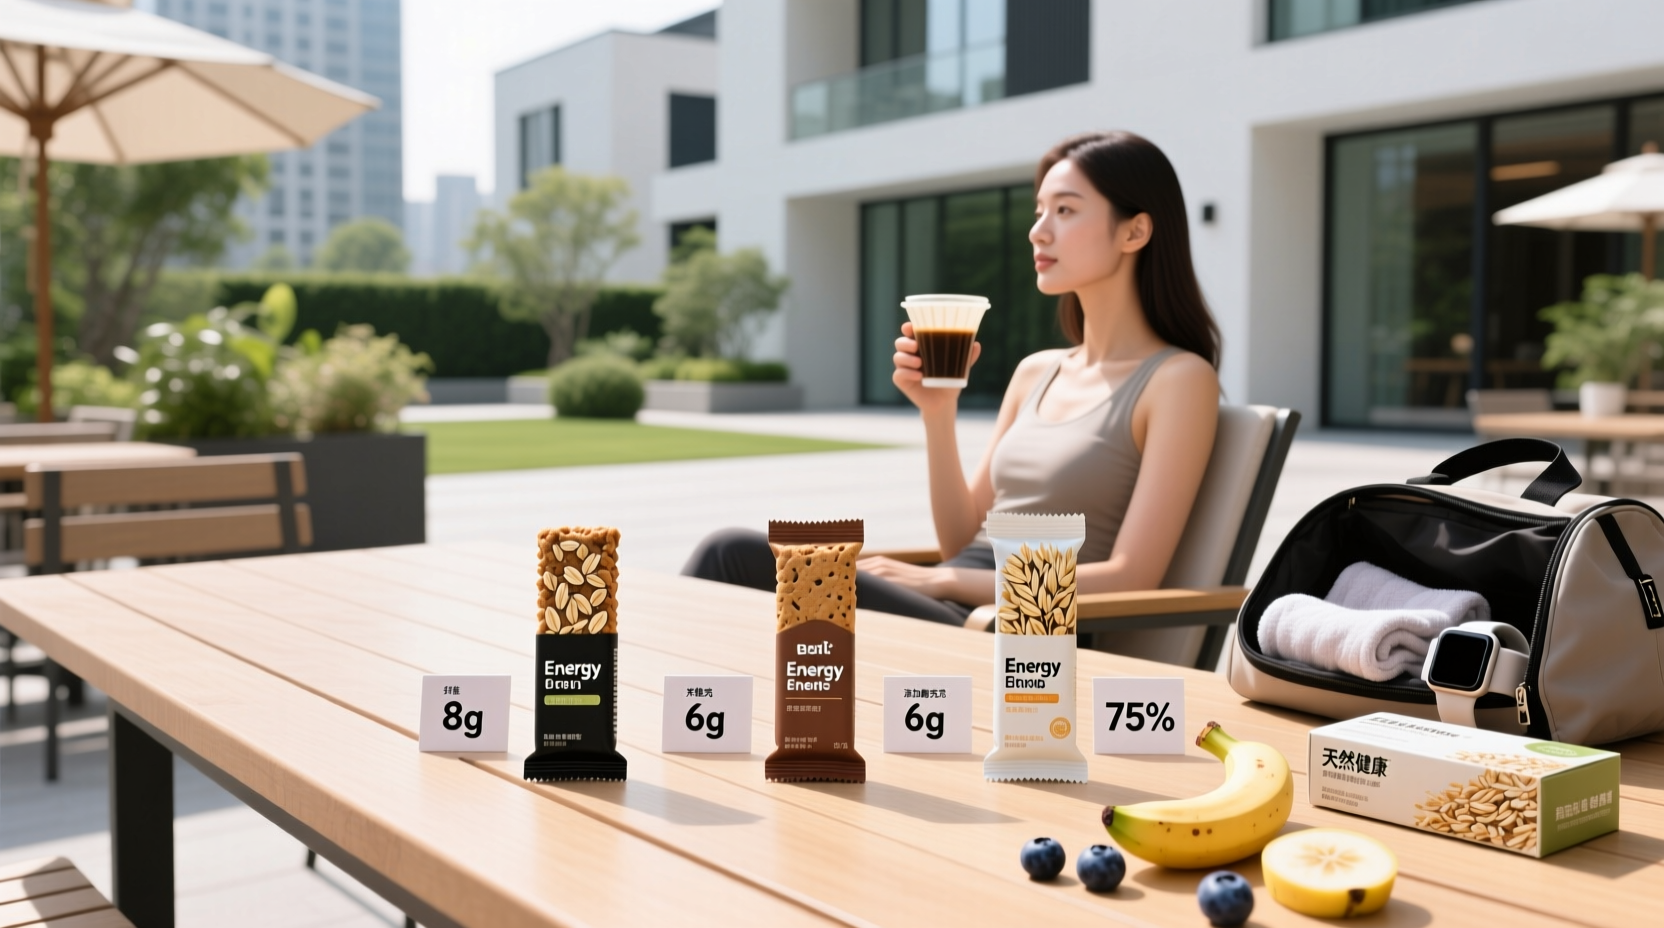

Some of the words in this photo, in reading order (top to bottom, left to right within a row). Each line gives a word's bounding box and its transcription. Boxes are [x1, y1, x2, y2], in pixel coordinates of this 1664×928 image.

[544, 660, 601, 680] Energy
[786, 661, 844, 682] Energy
[1004, 657, 1062, 678] Energy
[442, 700, 484, 739] 8g
[685, 702, 725, 740] 6g
[904, 702, 945, 740] 6g
[1105, 701, 1176, 732] 75%
[1322, 747, 1388, 778] 天然健康
